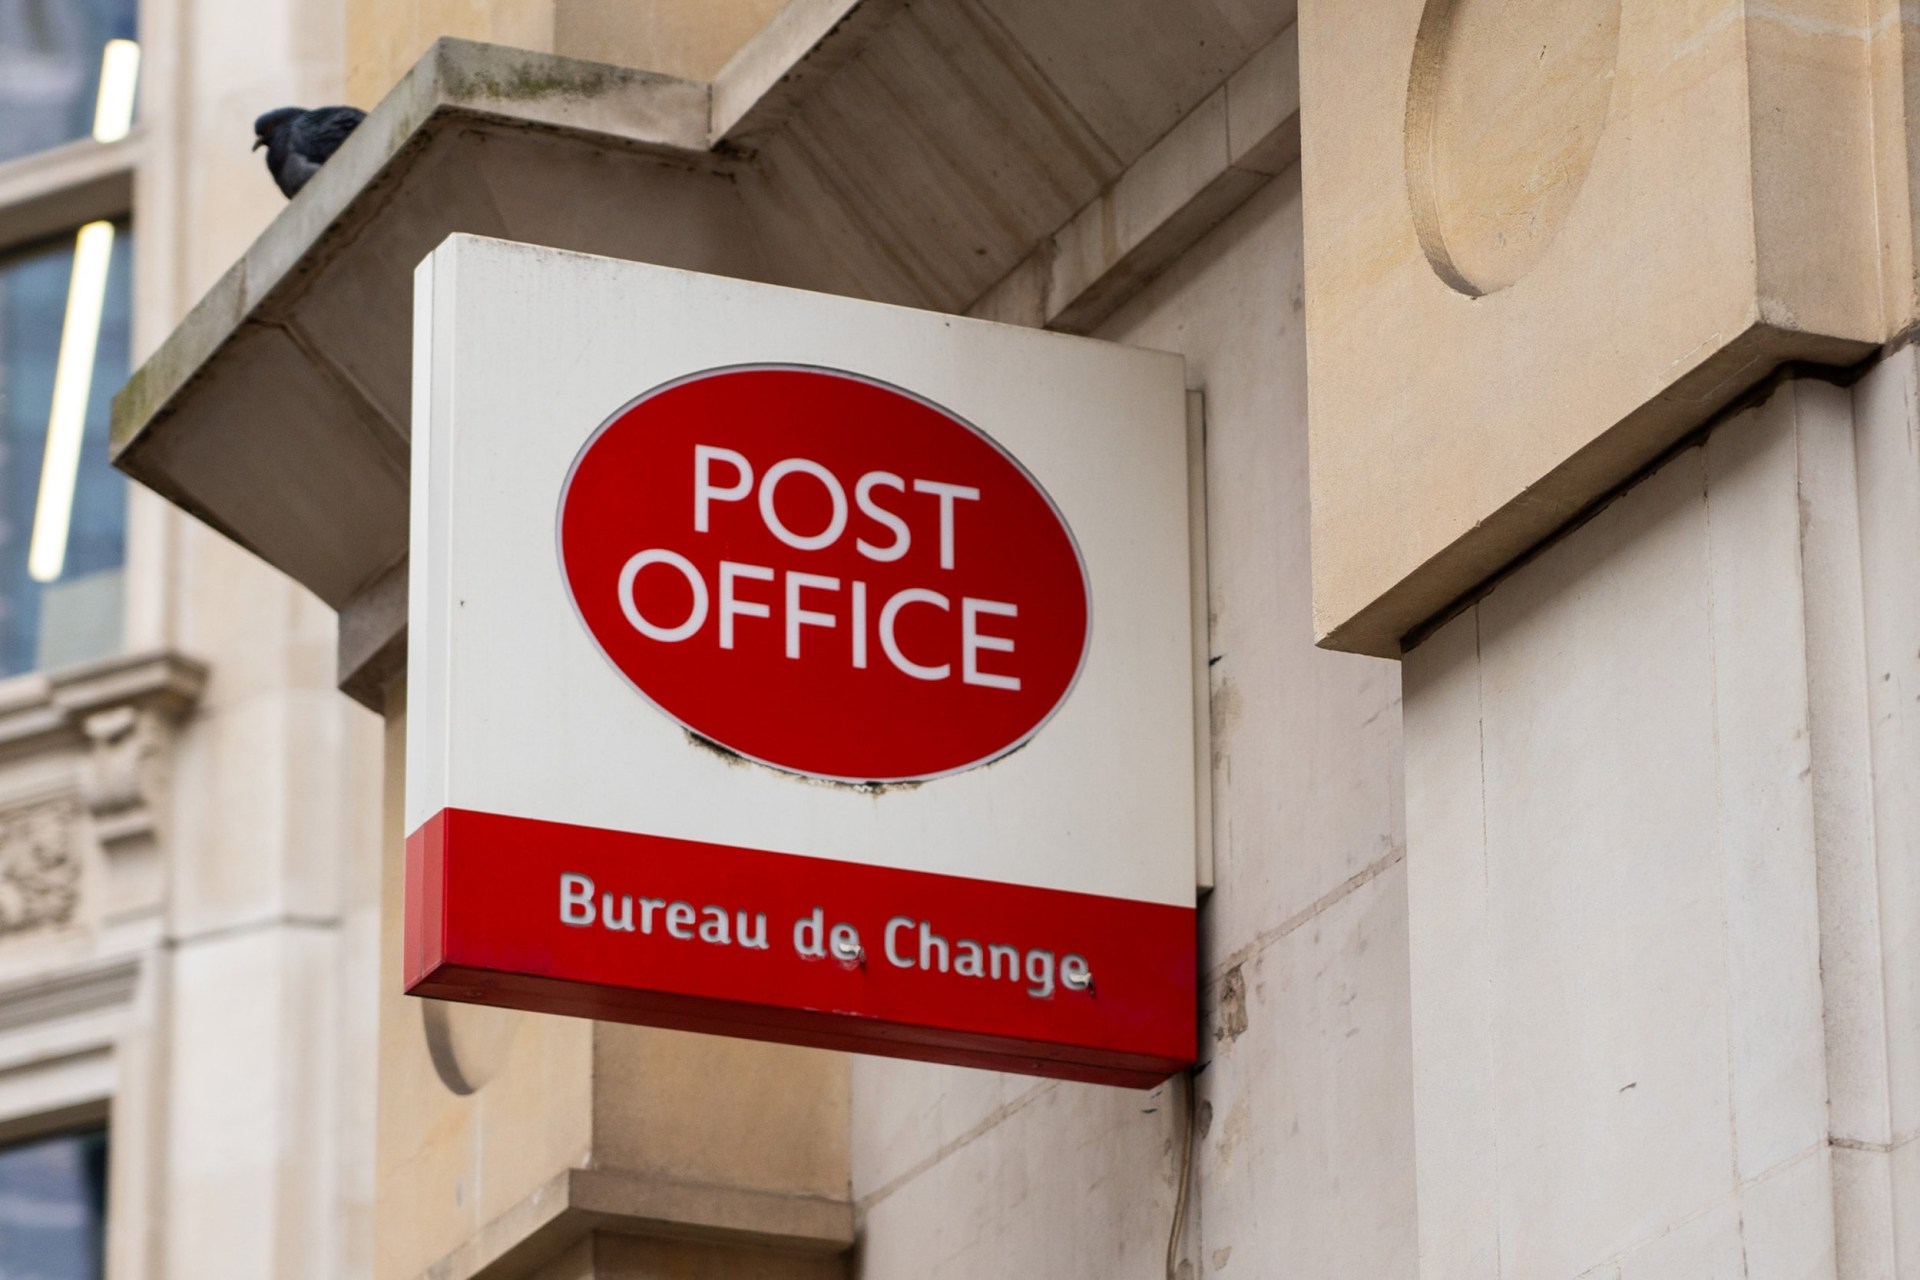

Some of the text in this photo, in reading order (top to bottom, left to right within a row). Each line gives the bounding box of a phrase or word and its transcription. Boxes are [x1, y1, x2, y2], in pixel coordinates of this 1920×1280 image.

[694, 444, 980, 570] POST
[617, 548, 1021, 691] OFFICE
[559, 872, 1092, 998] Bureau de Change
